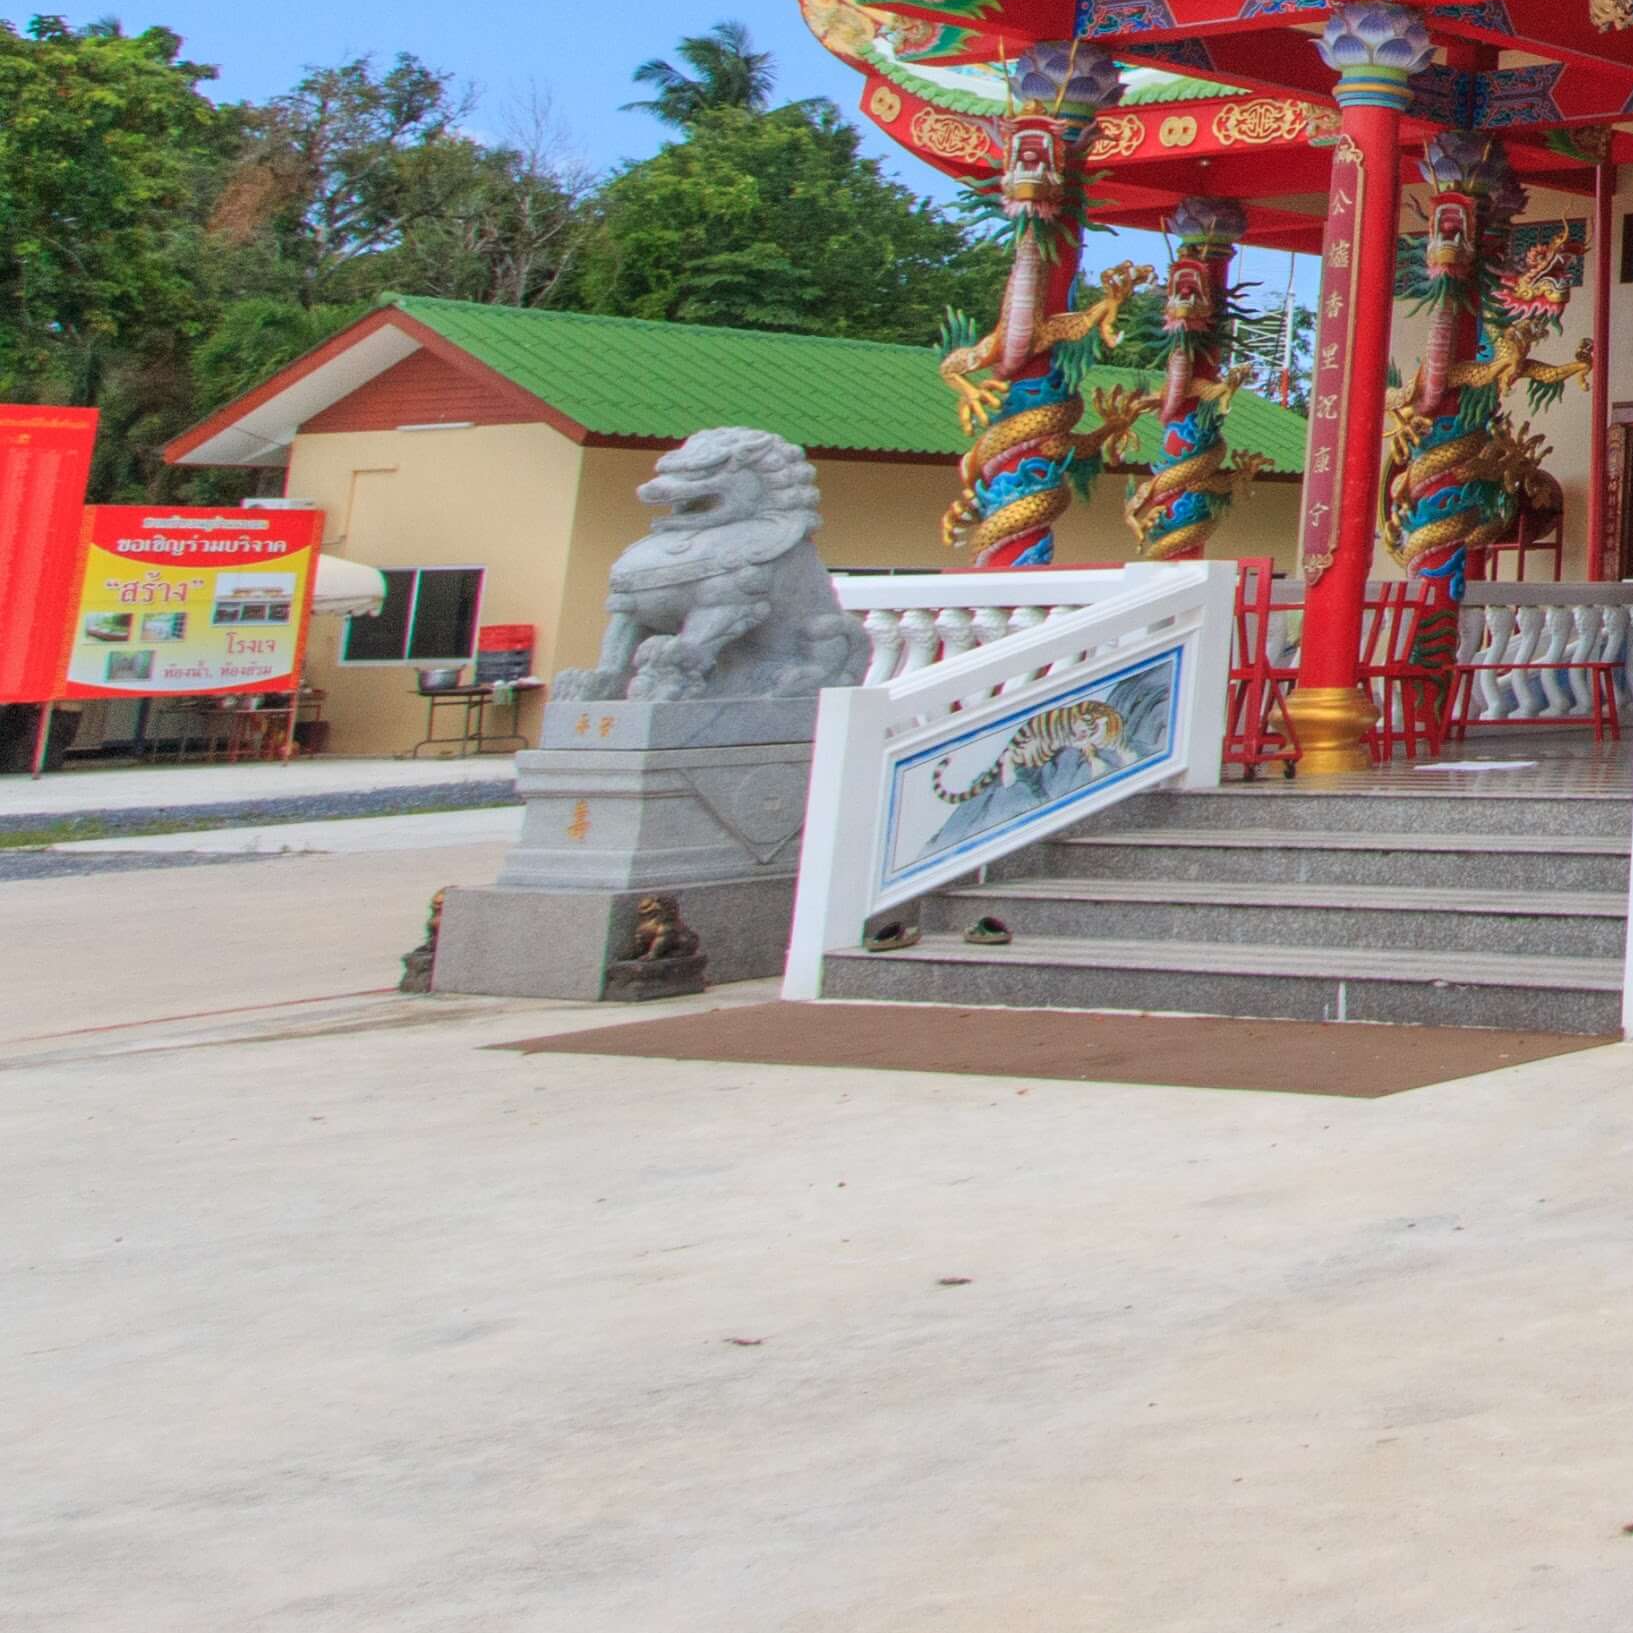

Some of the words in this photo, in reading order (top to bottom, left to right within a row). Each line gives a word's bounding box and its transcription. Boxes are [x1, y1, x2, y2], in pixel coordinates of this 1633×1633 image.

[117, 534, 288, 557] ขอเชิญร่วมบริจาค
[225, 631, 277, 655] โรงเจ
